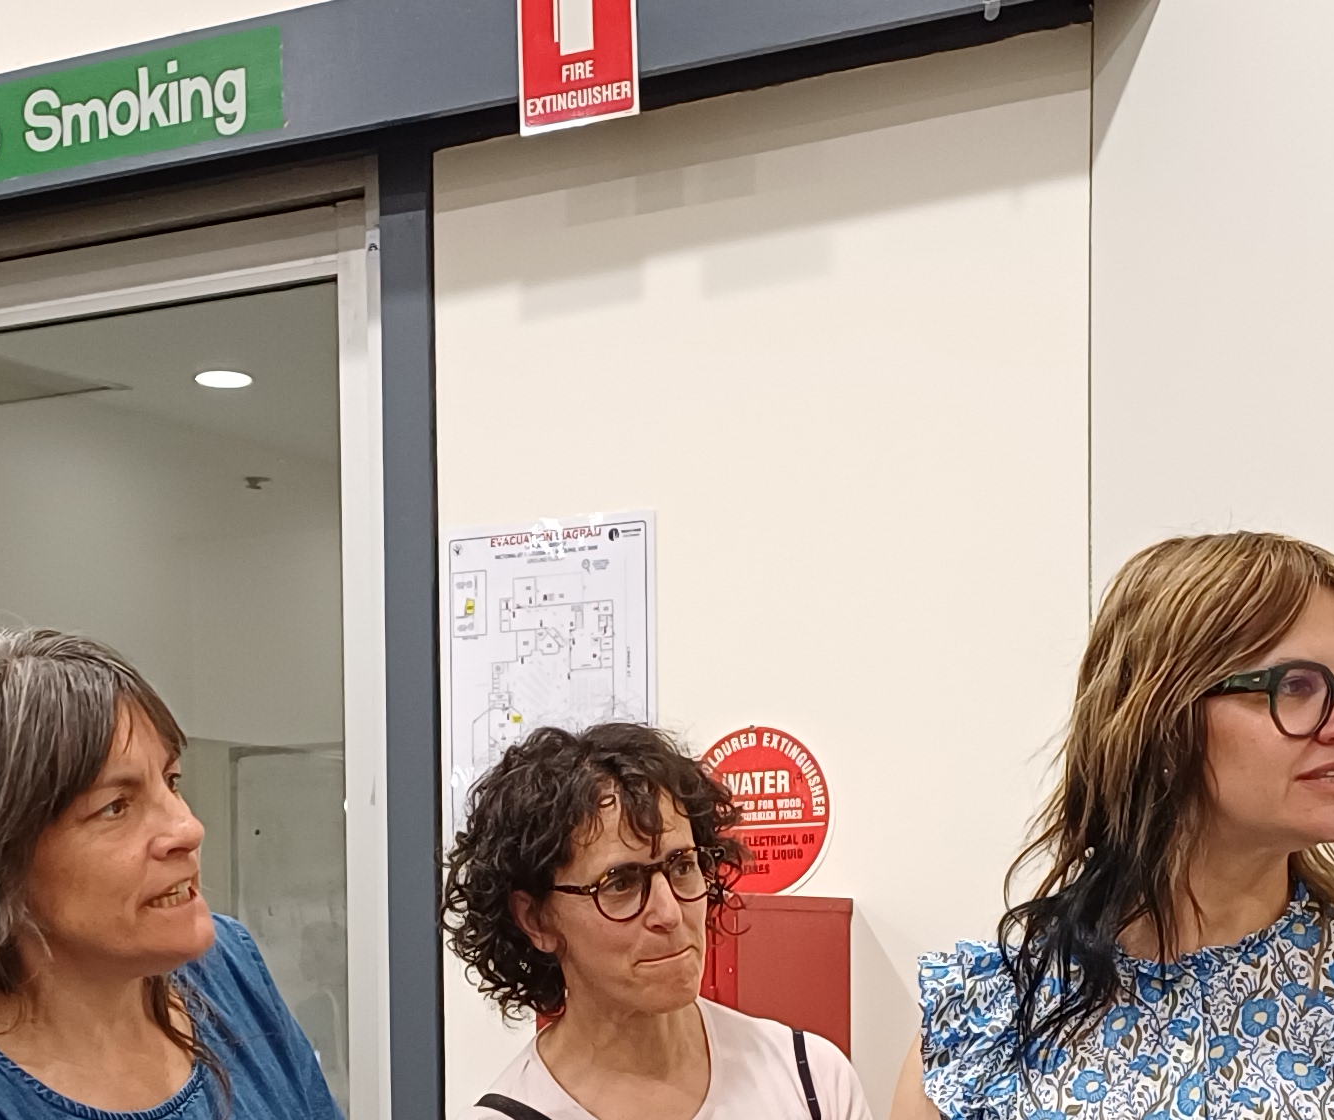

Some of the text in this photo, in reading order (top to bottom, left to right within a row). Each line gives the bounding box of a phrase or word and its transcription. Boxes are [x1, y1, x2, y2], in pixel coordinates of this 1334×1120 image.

[561, 60, 594, 83] FIRE
[24, 60, 247, 152] Smoking
[526, 81, 632, 117] EXTINGUISHER
[701, 732, 826, 817] OLOURED EXTINGUISHER
[722, 770, 790, 796] WATER
[757, 799, 774, 810] FOR
[802, 833, 815, 845] OR
[772, 848, 803, 860] LIQUID
